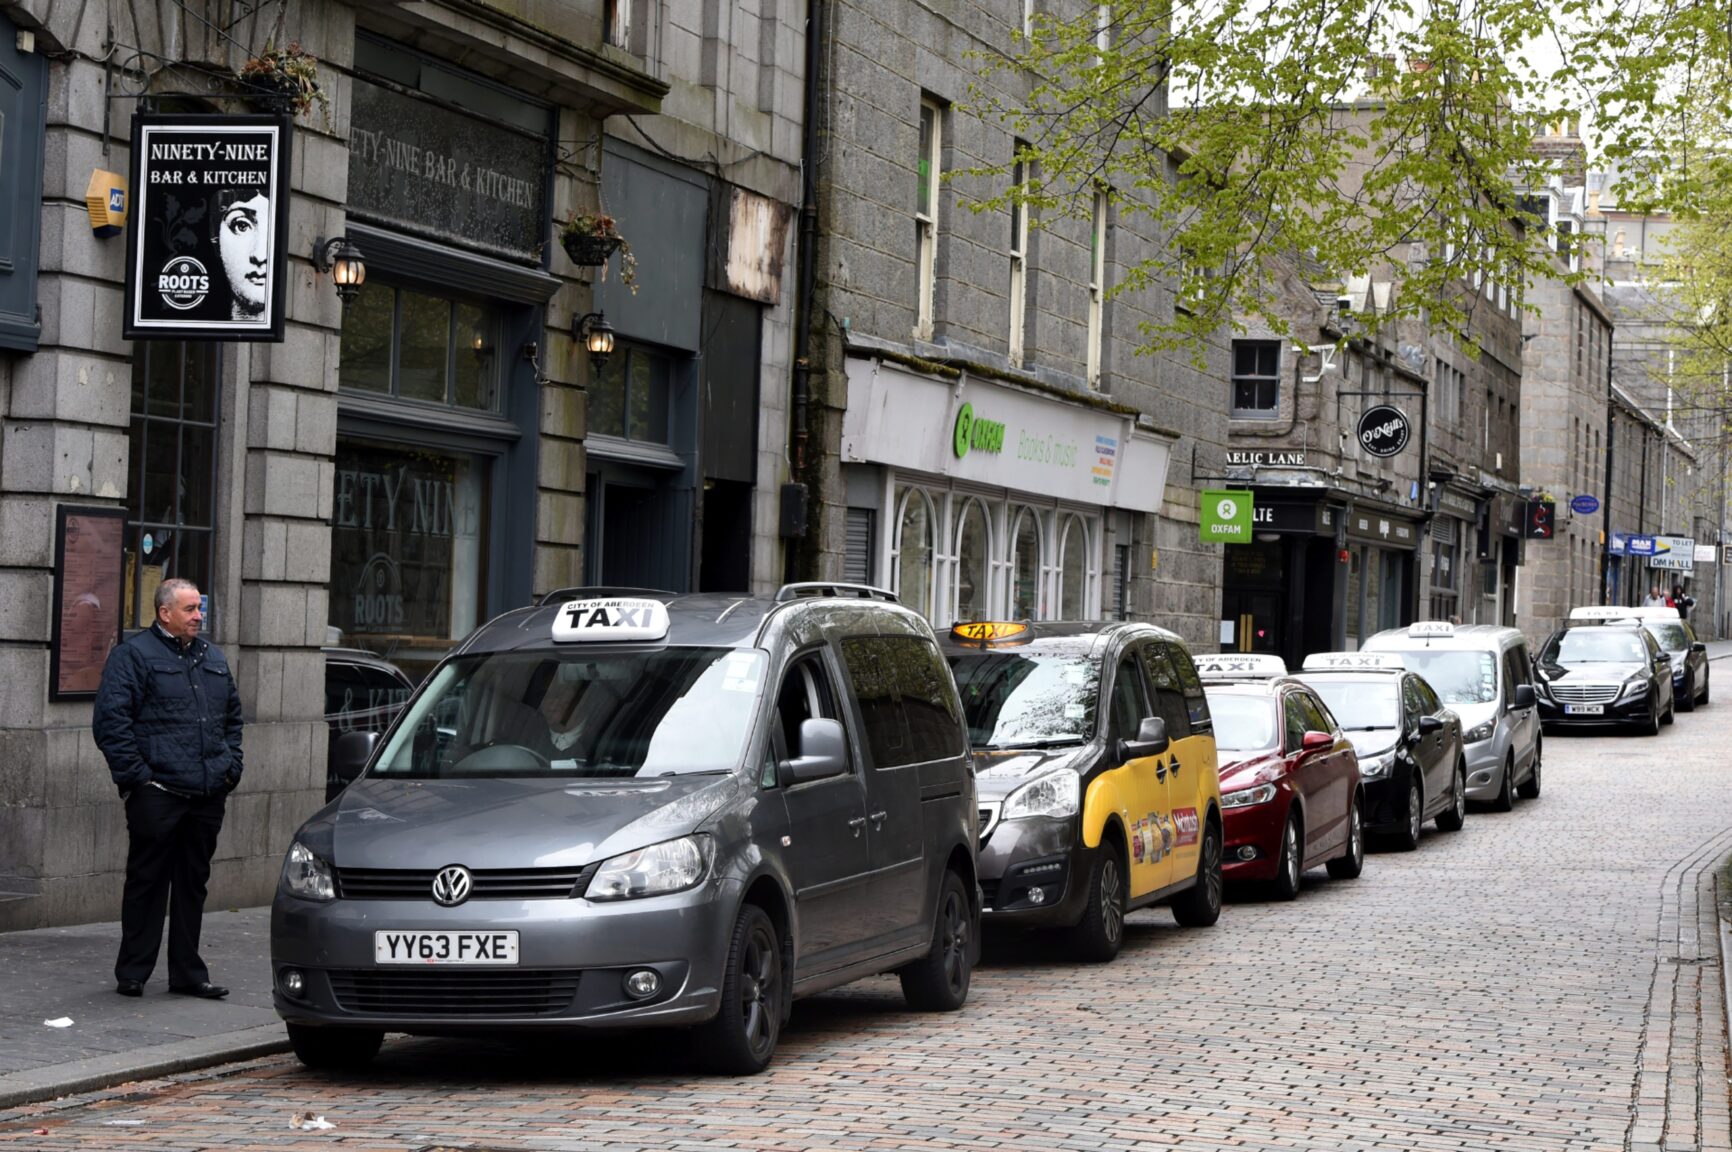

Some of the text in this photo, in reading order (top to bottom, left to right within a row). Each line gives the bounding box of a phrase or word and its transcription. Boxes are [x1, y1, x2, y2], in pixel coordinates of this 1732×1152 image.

[151, 141, 269, 161] NINETY-NINE
[150, 170, 267, 184] BAR & KITCHEN
[425, 151, 457, 187] BAR
[460, 162, 471, 191] &
[476, 166, 534, 209] KITCHEN
[158, 274, 210, 290] ROOTS
[971, 417, 1006, 454] OXFAM
[1268, 453, 1305, 465] LANE
[410, 478, 478, 536] NINE
[1211, 524, 1242, 534] OXFAM
[1653, 558, 1667, 567] DM
[354, 594, 404, 624] ROOTS
[567, 602, 588, 610] CITY
[566, 607, 653, 629] TAXI
[967, 624, 1009, 639] TAXI
[1414, 624, 1450, 632] TAXI
[1326, 658, 1382, 666] TAXI
[386, 934, 508, 960] YY63 FXE
